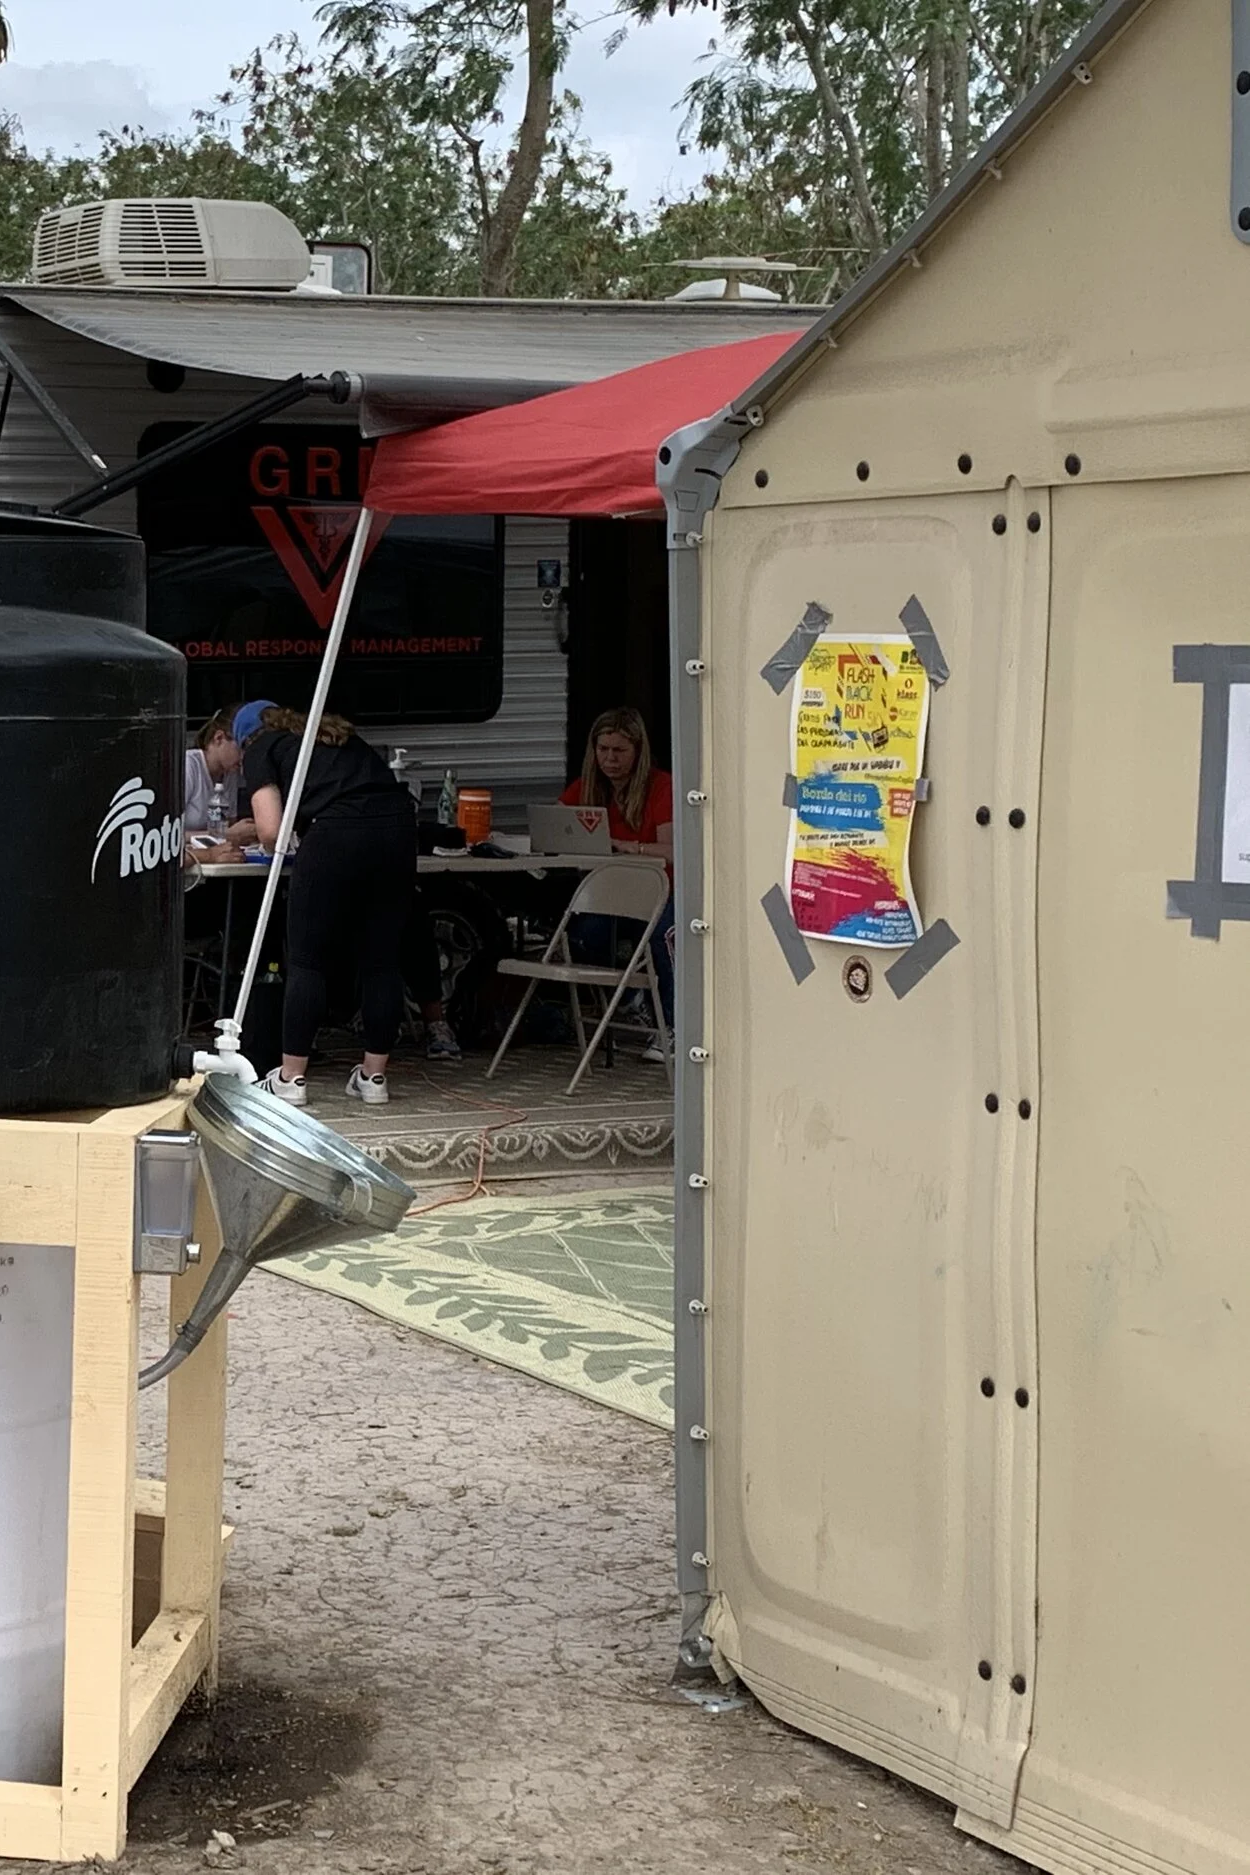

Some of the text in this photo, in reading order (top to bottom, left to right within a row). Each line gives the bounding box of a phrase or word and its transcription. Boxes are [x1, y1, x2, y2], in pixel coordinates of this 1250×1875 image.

[246, 638, 342, 656] RESPON
[351, 636, 482, 655] MANAGEMENT
[844, 703, 866, 720] RUN
[119, 812, 185, 878] Roto
